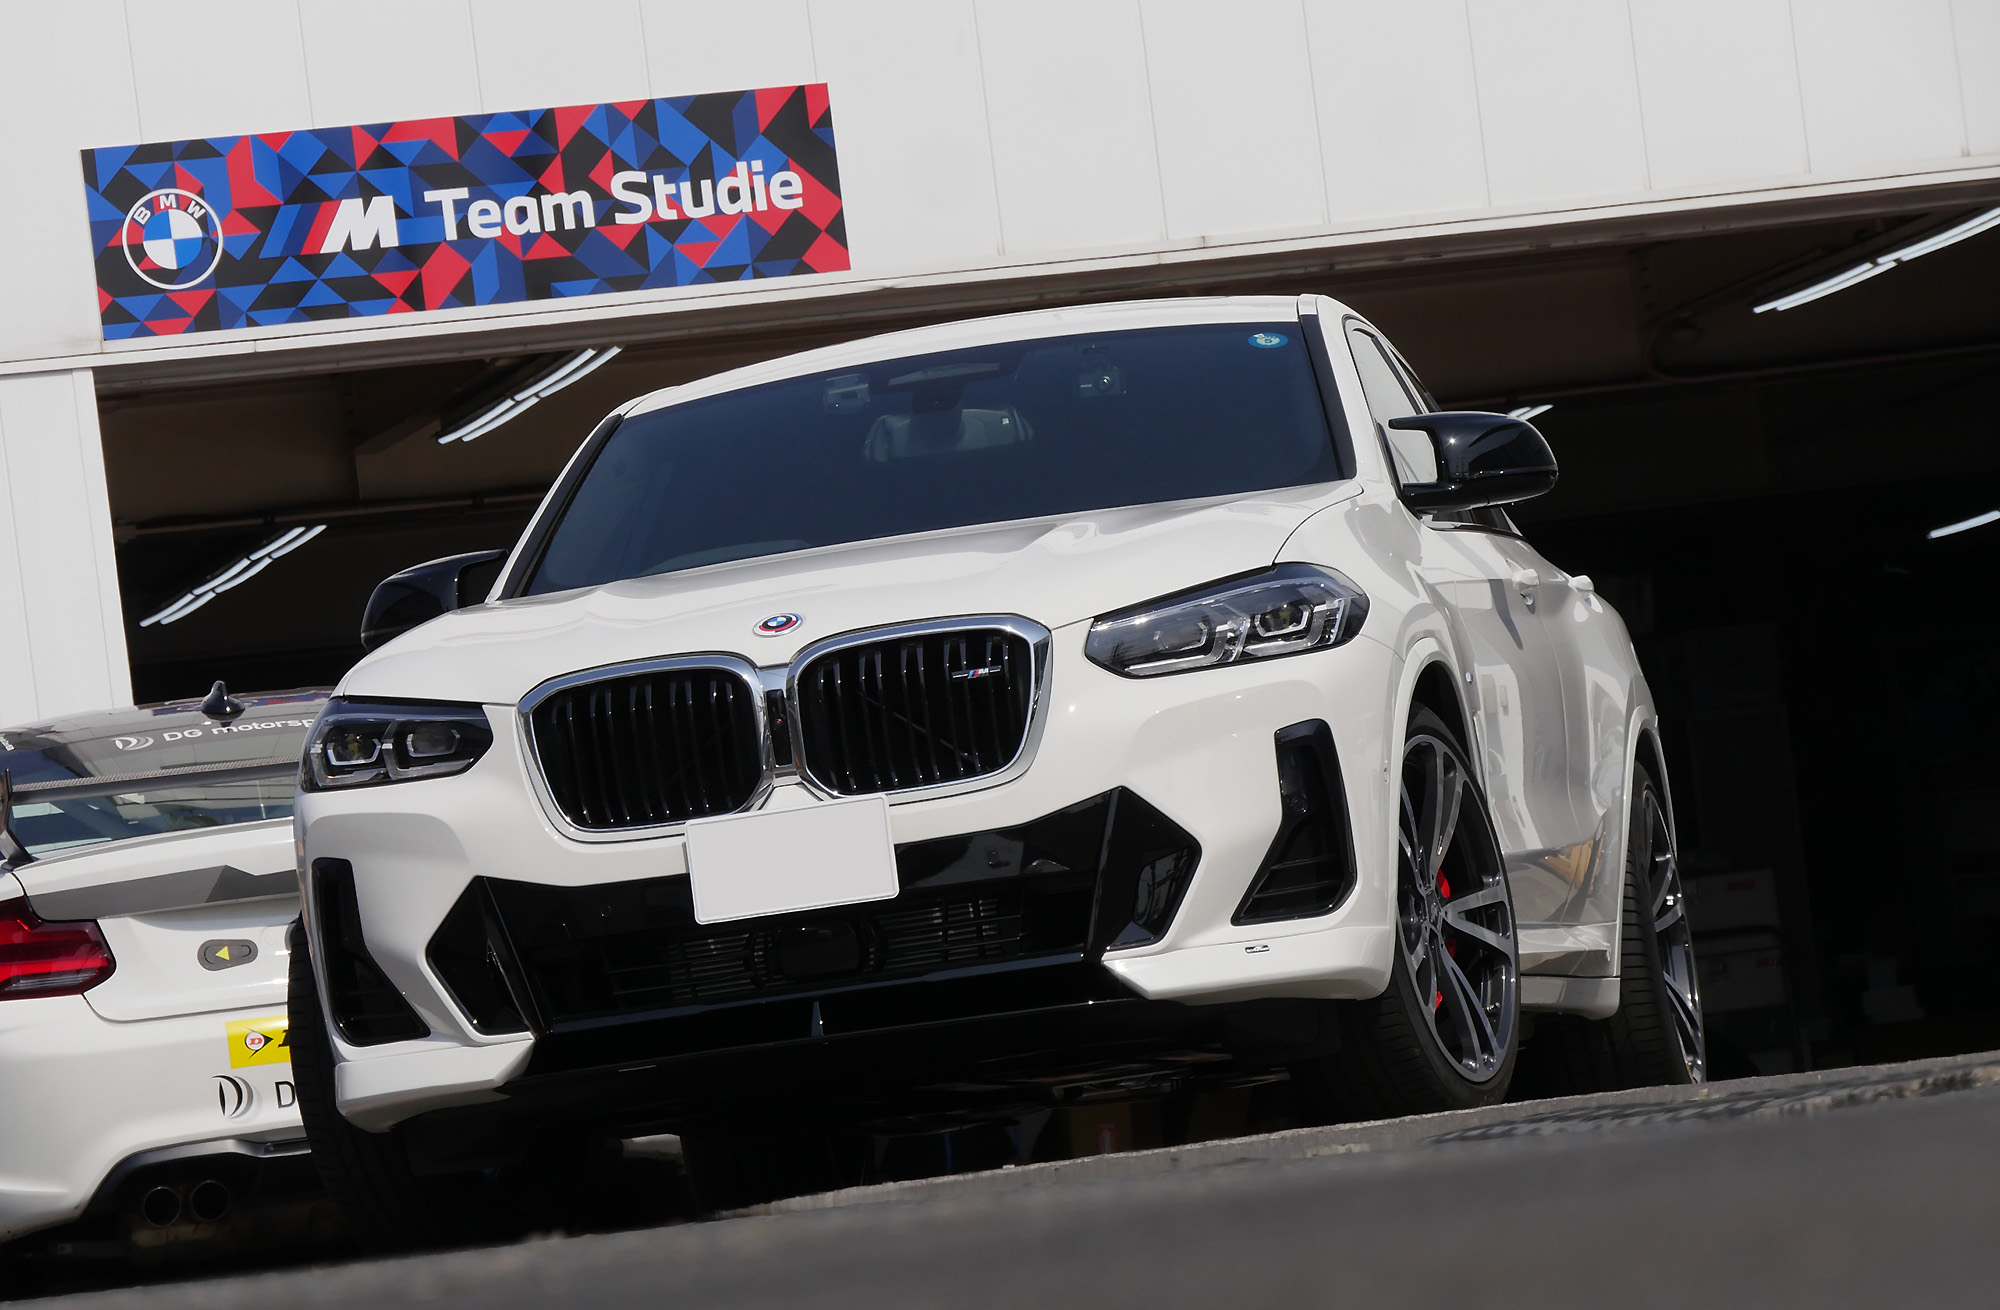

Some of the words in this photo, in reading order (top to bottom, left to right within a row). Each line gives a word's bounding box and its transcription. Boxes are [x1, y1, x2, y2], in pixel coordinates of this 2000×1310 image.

[133, 194, 206, 226] BMW
[424, 187, 596, 241] Team
[610, 160, 804, 225] Studie
[163, 729, 203, 742] DG
